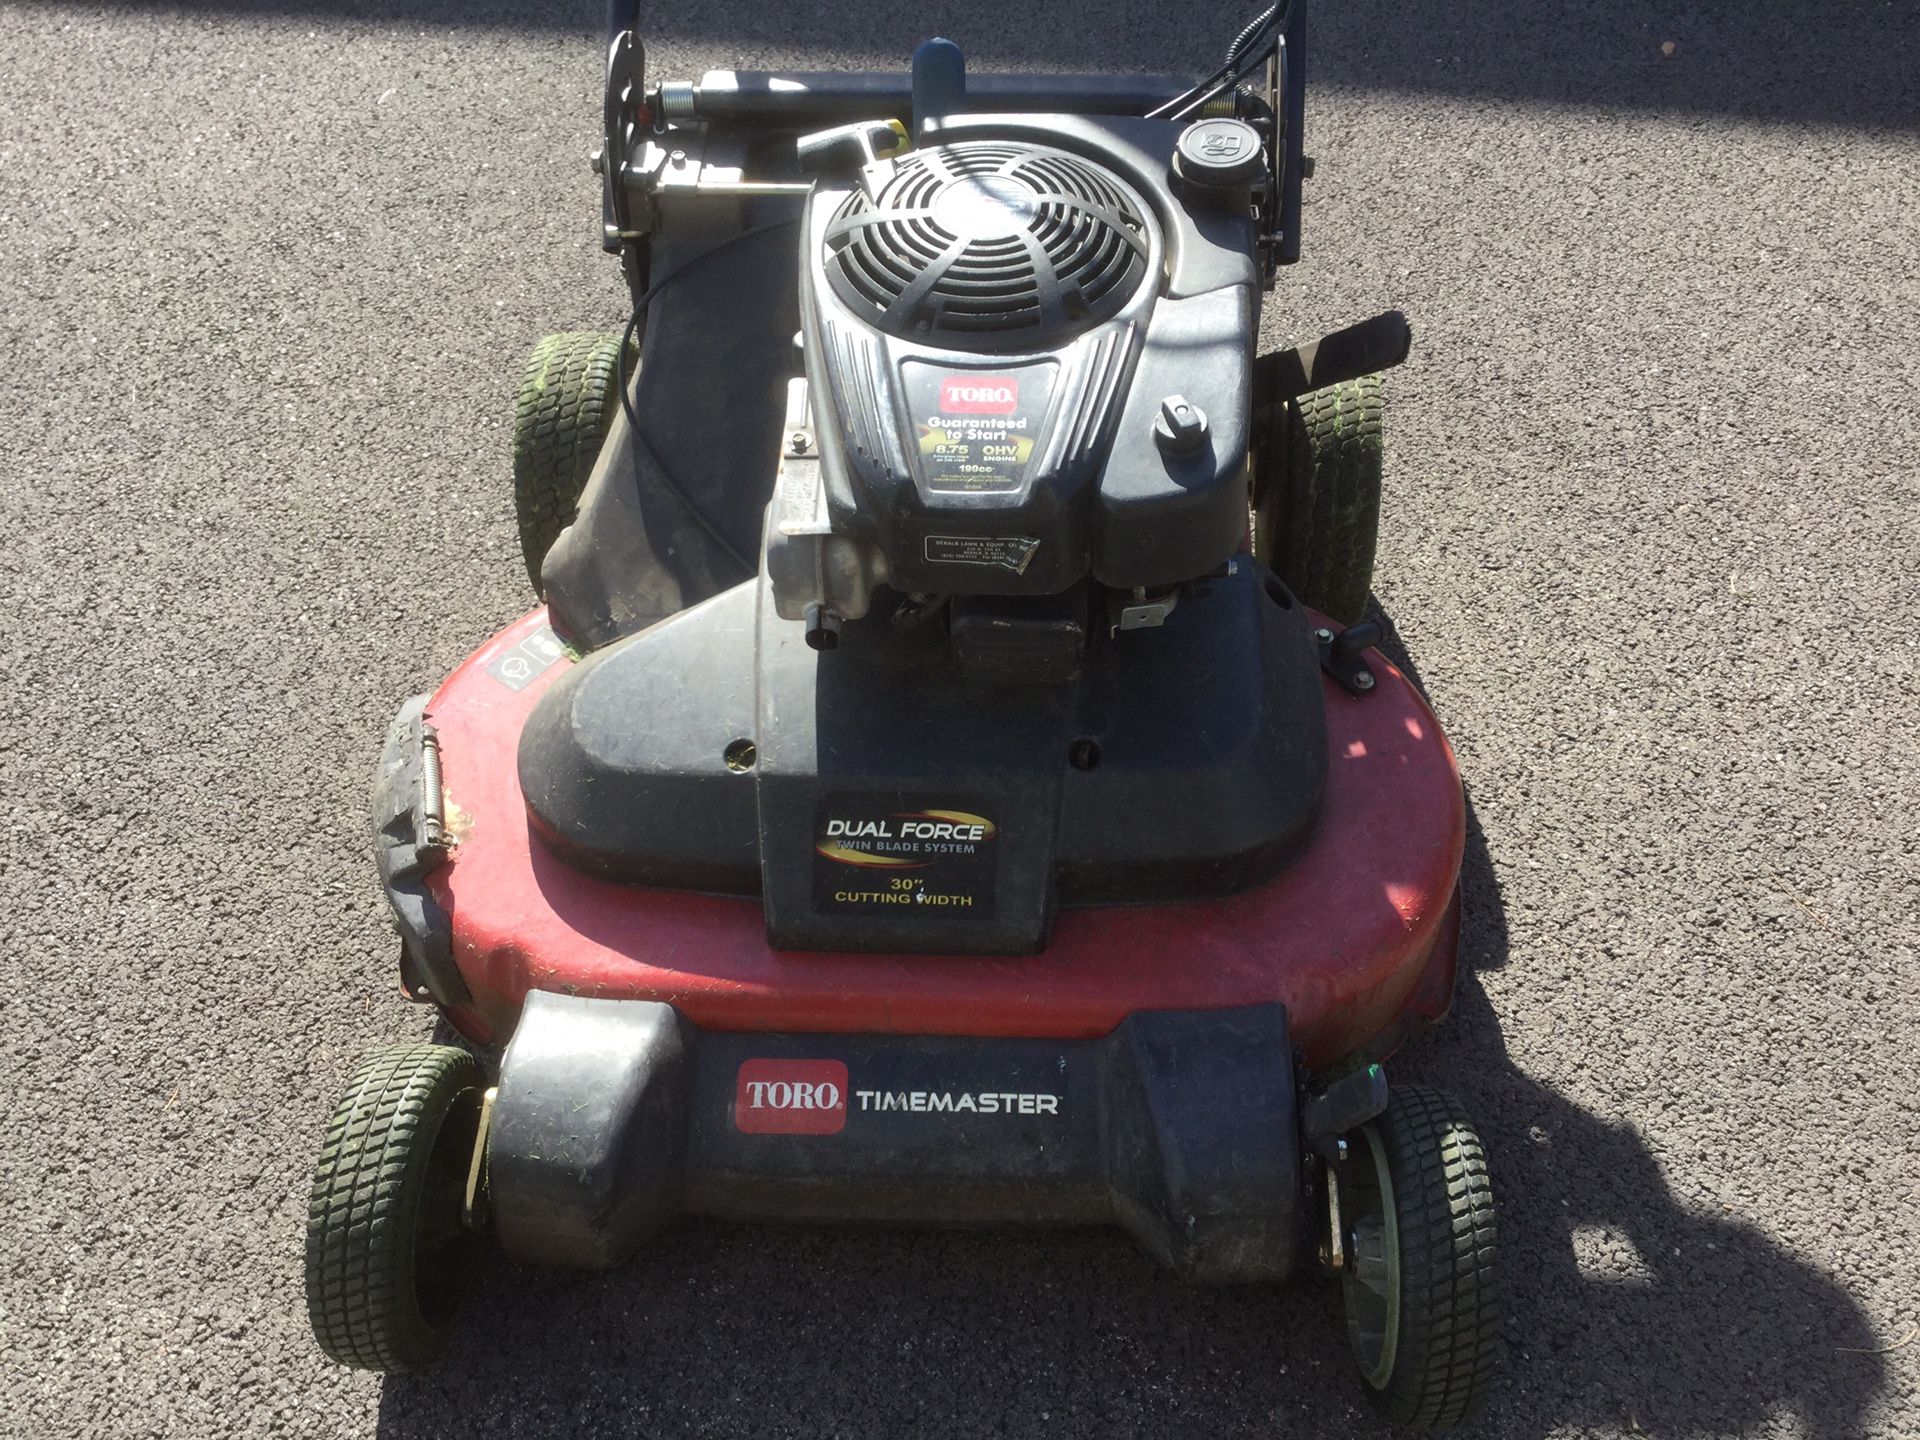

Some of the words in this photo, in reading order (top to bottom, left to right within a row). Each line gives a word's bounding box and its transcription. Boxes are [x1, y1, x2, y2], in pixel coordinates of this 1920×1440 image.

[947, 387, 1013, 402] TORO
[928, 416, 1027, 428] Guaranteed
[946, 430, 962, 439] to
[967, 429, 1007, 440] Start
[936, 445, 969, 454] 8.75
[982, 445, 1017, 455] OHV
[826, 820, 892, 838] DUAL
[901, 822, 986, 841] FORCE
[836, 840, 871, 850] TWIN
[877, 841, 920, 852] BLADE
[925, 843, 975, 854] SYSTEM
[835, 891, 911, 904] CUTTING
[746, 1081, 839, 1110] TORO
[856, 1090, 1059, 1115] TIMEMASTER
